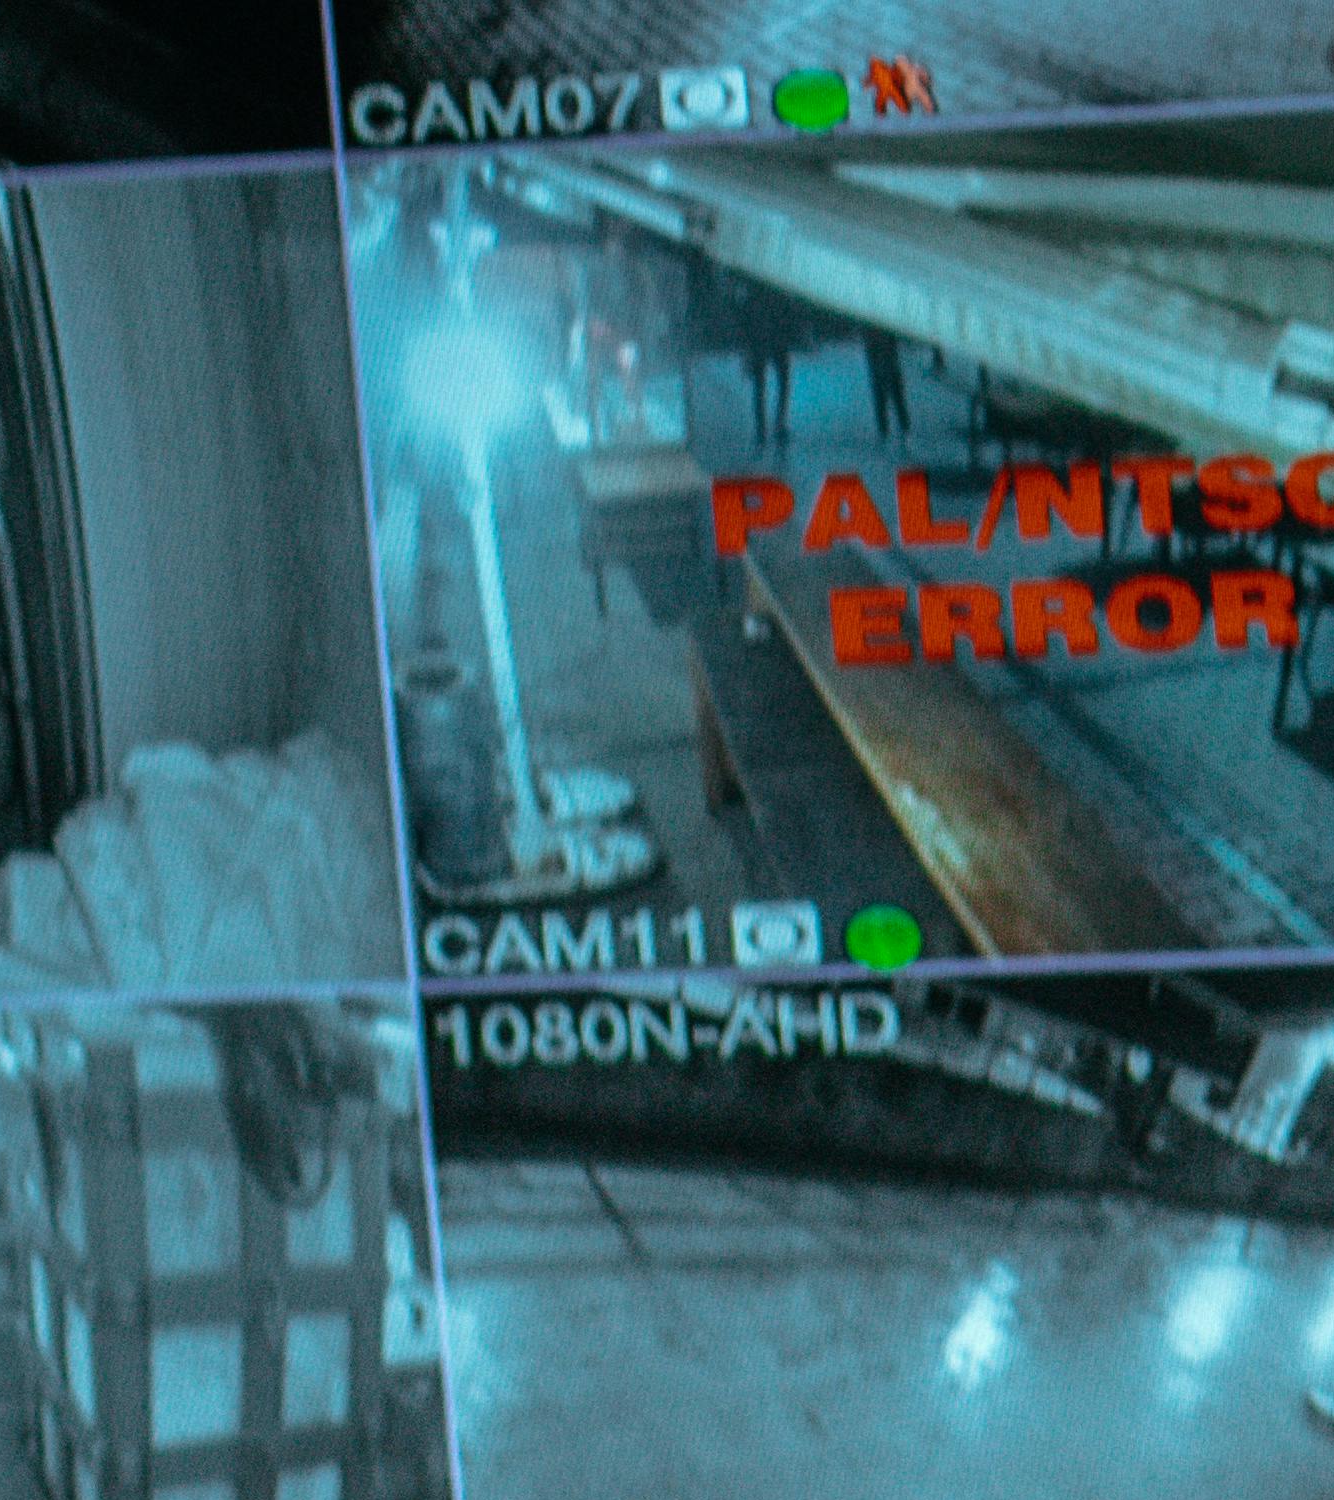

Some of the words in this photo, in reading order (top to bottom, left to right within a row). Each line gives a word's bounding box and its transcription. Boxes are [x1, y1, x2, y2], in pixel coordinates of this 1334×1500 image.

[350, 72, 641, 145] CAM07
[828, 569, 1301, 667] ERROR
[424, 905, 707, 975] CAM11
[436, 990, 901, 1068] 1080N-AHD
